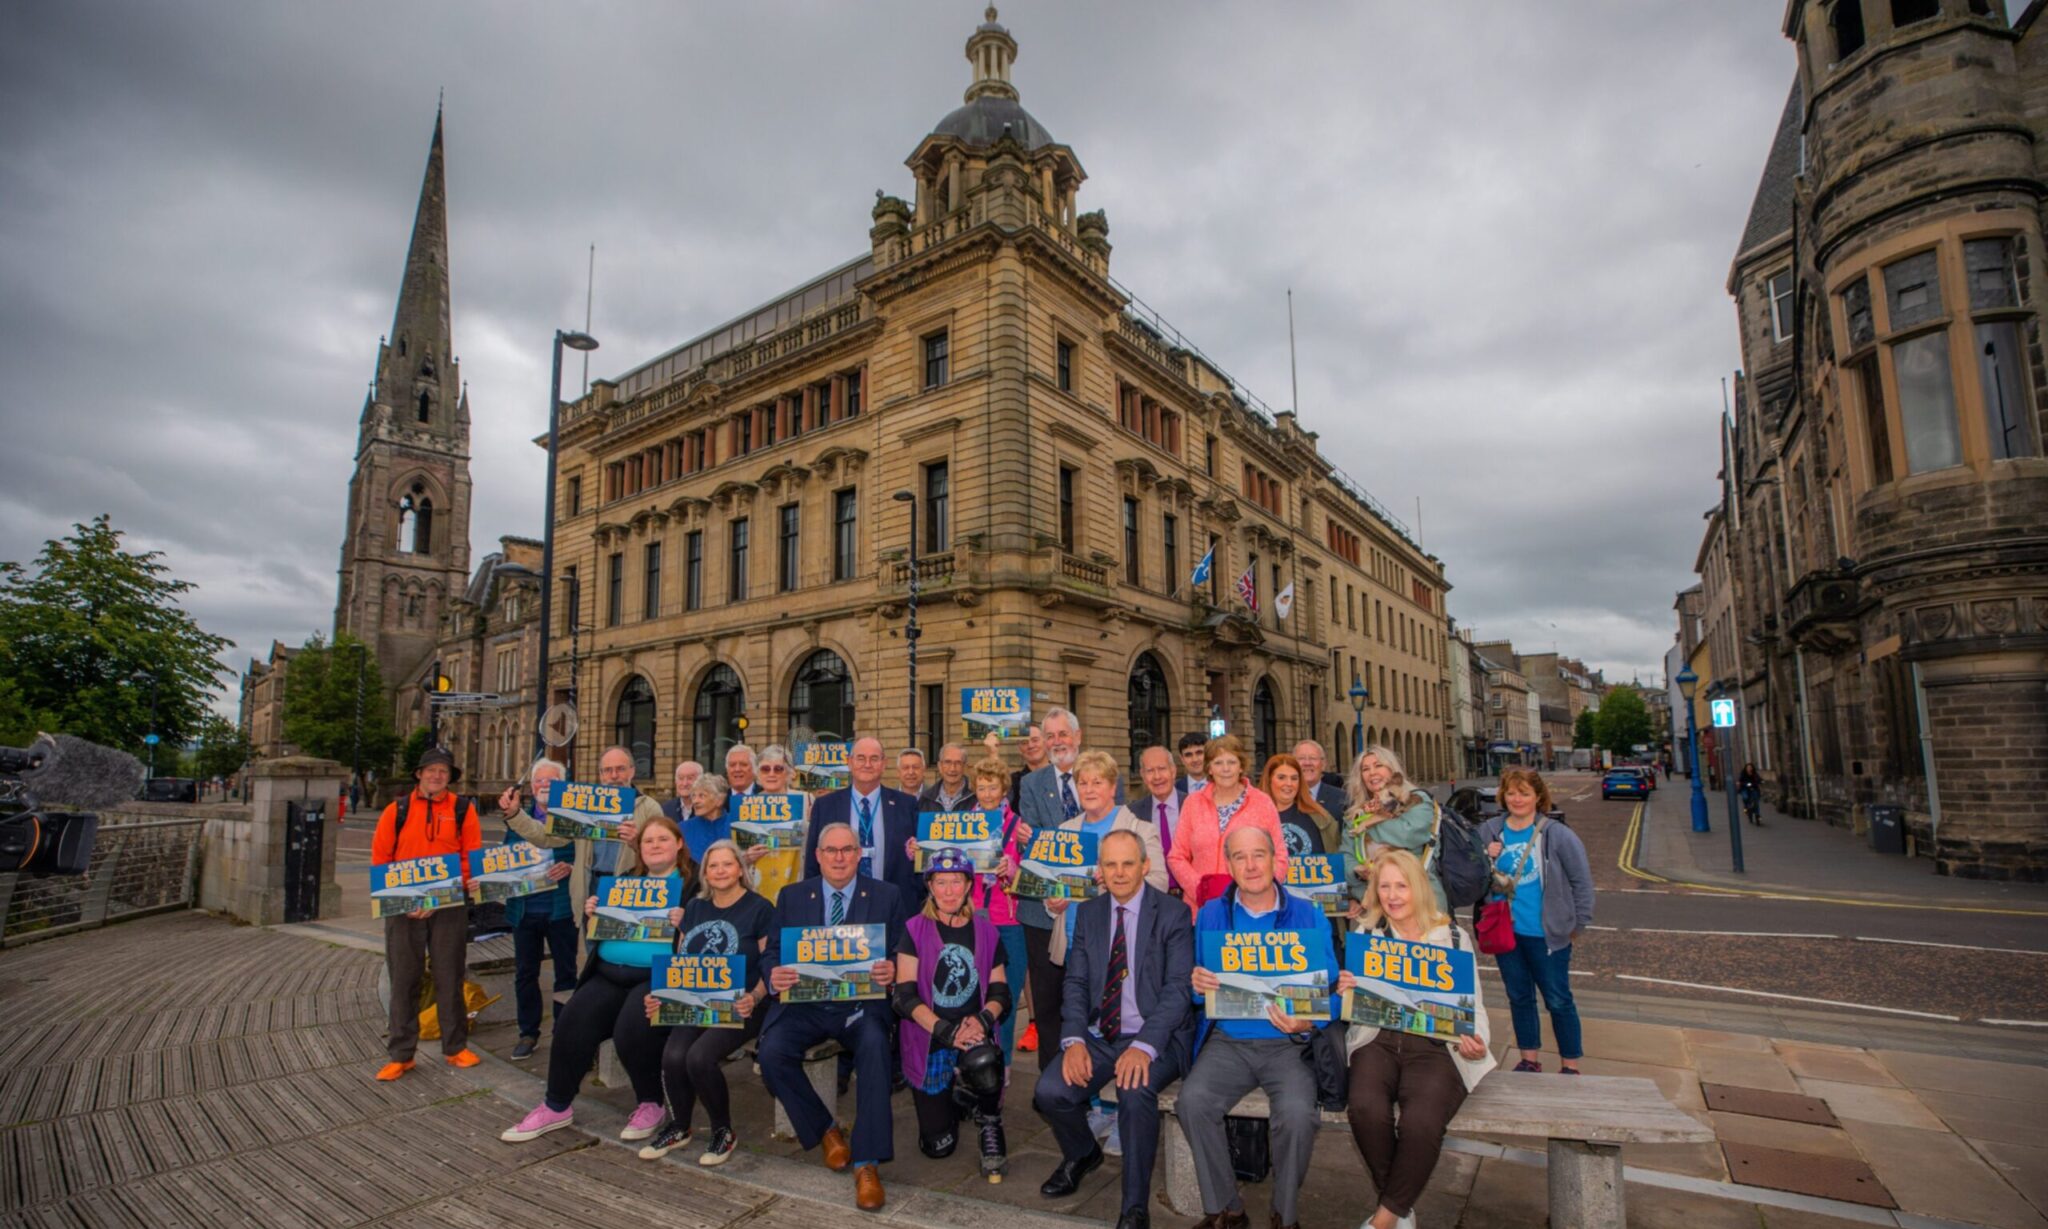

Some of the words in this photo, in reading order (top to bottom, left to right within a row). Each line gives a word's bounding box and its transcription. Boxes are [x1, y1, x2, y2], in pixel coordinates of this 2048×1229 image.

[974, 689, 995, 698] SAVE
[996, 689, 1017, 698] OUR
[971, 697, 1020, 713] BELLS
[807, 743, 827, 751] SAVE
[828, 743, 847, 751] OUR
[804, 750, 849, 765] BELLS
[567, 783, 594, 795] SAVE
[595, 786, 620, 797] OUR
[561, 792, 621, 813] BELLS
[742, 796, 765, 805] SAVE
[766, 796, 788, 805] OUR
[739, 804, 792, 821] BELLS
[934, 813, 960, 823] SAVE
[962, 813, 986, 823] OUR
[929, 822, 990, 840] BELLS
[1037, 831, 1056, 842] SAVE
[1056, 832, 1079, 844] OUR
[485, 845, 511, 856] SAVE
[512, 841, 535, 851] OUR
[1029, 839, 1084, 865] BELLS
[388, 860, 417, 872] SAVE
[418, 857, 444, 867] OUR
[482, 850, 542, 874] BELLS
[1303, 856, 1328, 866] OUR
[385, 865, 449, 888] BELLS
[1285, 865, 1334, 884] ELLS
[615, 878, 641, 889] SAVE
[643, 878, 667, 889] OUR
[607, 888, 669, 908] BELLS
[802, 929, 833, 940] SAVE
[835, 926, 865, 939] OUR
[1225, 932, 1262, 945] SAVE
[1265, 932, 1300, 946] OUR
[797, 939, 871, 962] BELLS
[1370, 939, 1408, 955] SAVE
[1411, 946, 1447, 963] OUR
[670, 956, 700, 967] SAVE
[703, 956, 728, 968] OUR
[1220, 945, 1308, 972] BELLS
[666, 967, 732, 989] BELLS
[1363, 952, 1455, 991] BELLS
